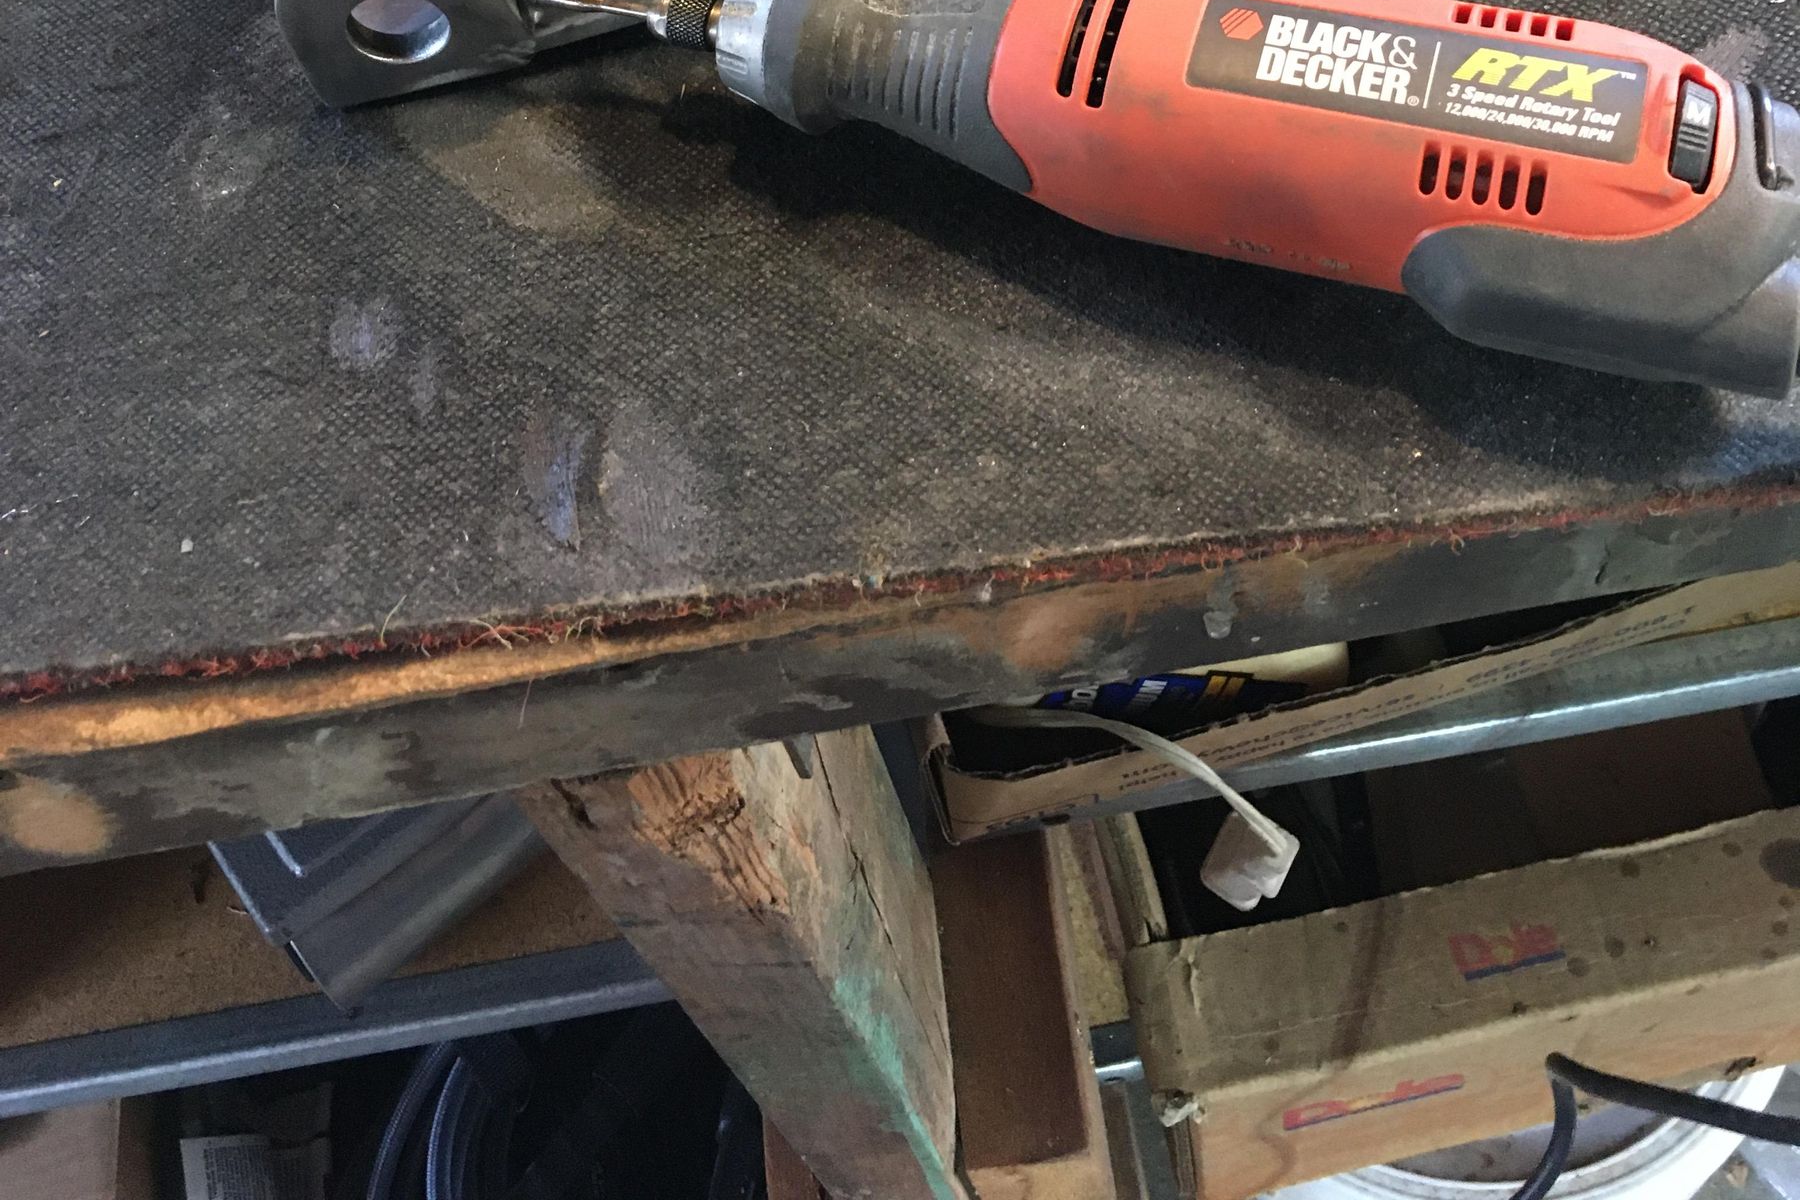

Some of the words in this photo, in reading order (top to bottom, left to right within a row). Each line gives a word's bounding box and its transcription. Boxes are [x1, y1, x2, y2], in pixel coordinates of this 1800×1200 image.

[1452, 47, 1620, 103] RTX
[1446, 83, 1461, 98] 3
[1461, 86, 1519, 109] Speed
[1519, 96, 1579, 122] Rotary
[1582, 106, 1622, 127] Tool
[1578, 125, 1615, 143] RPM
